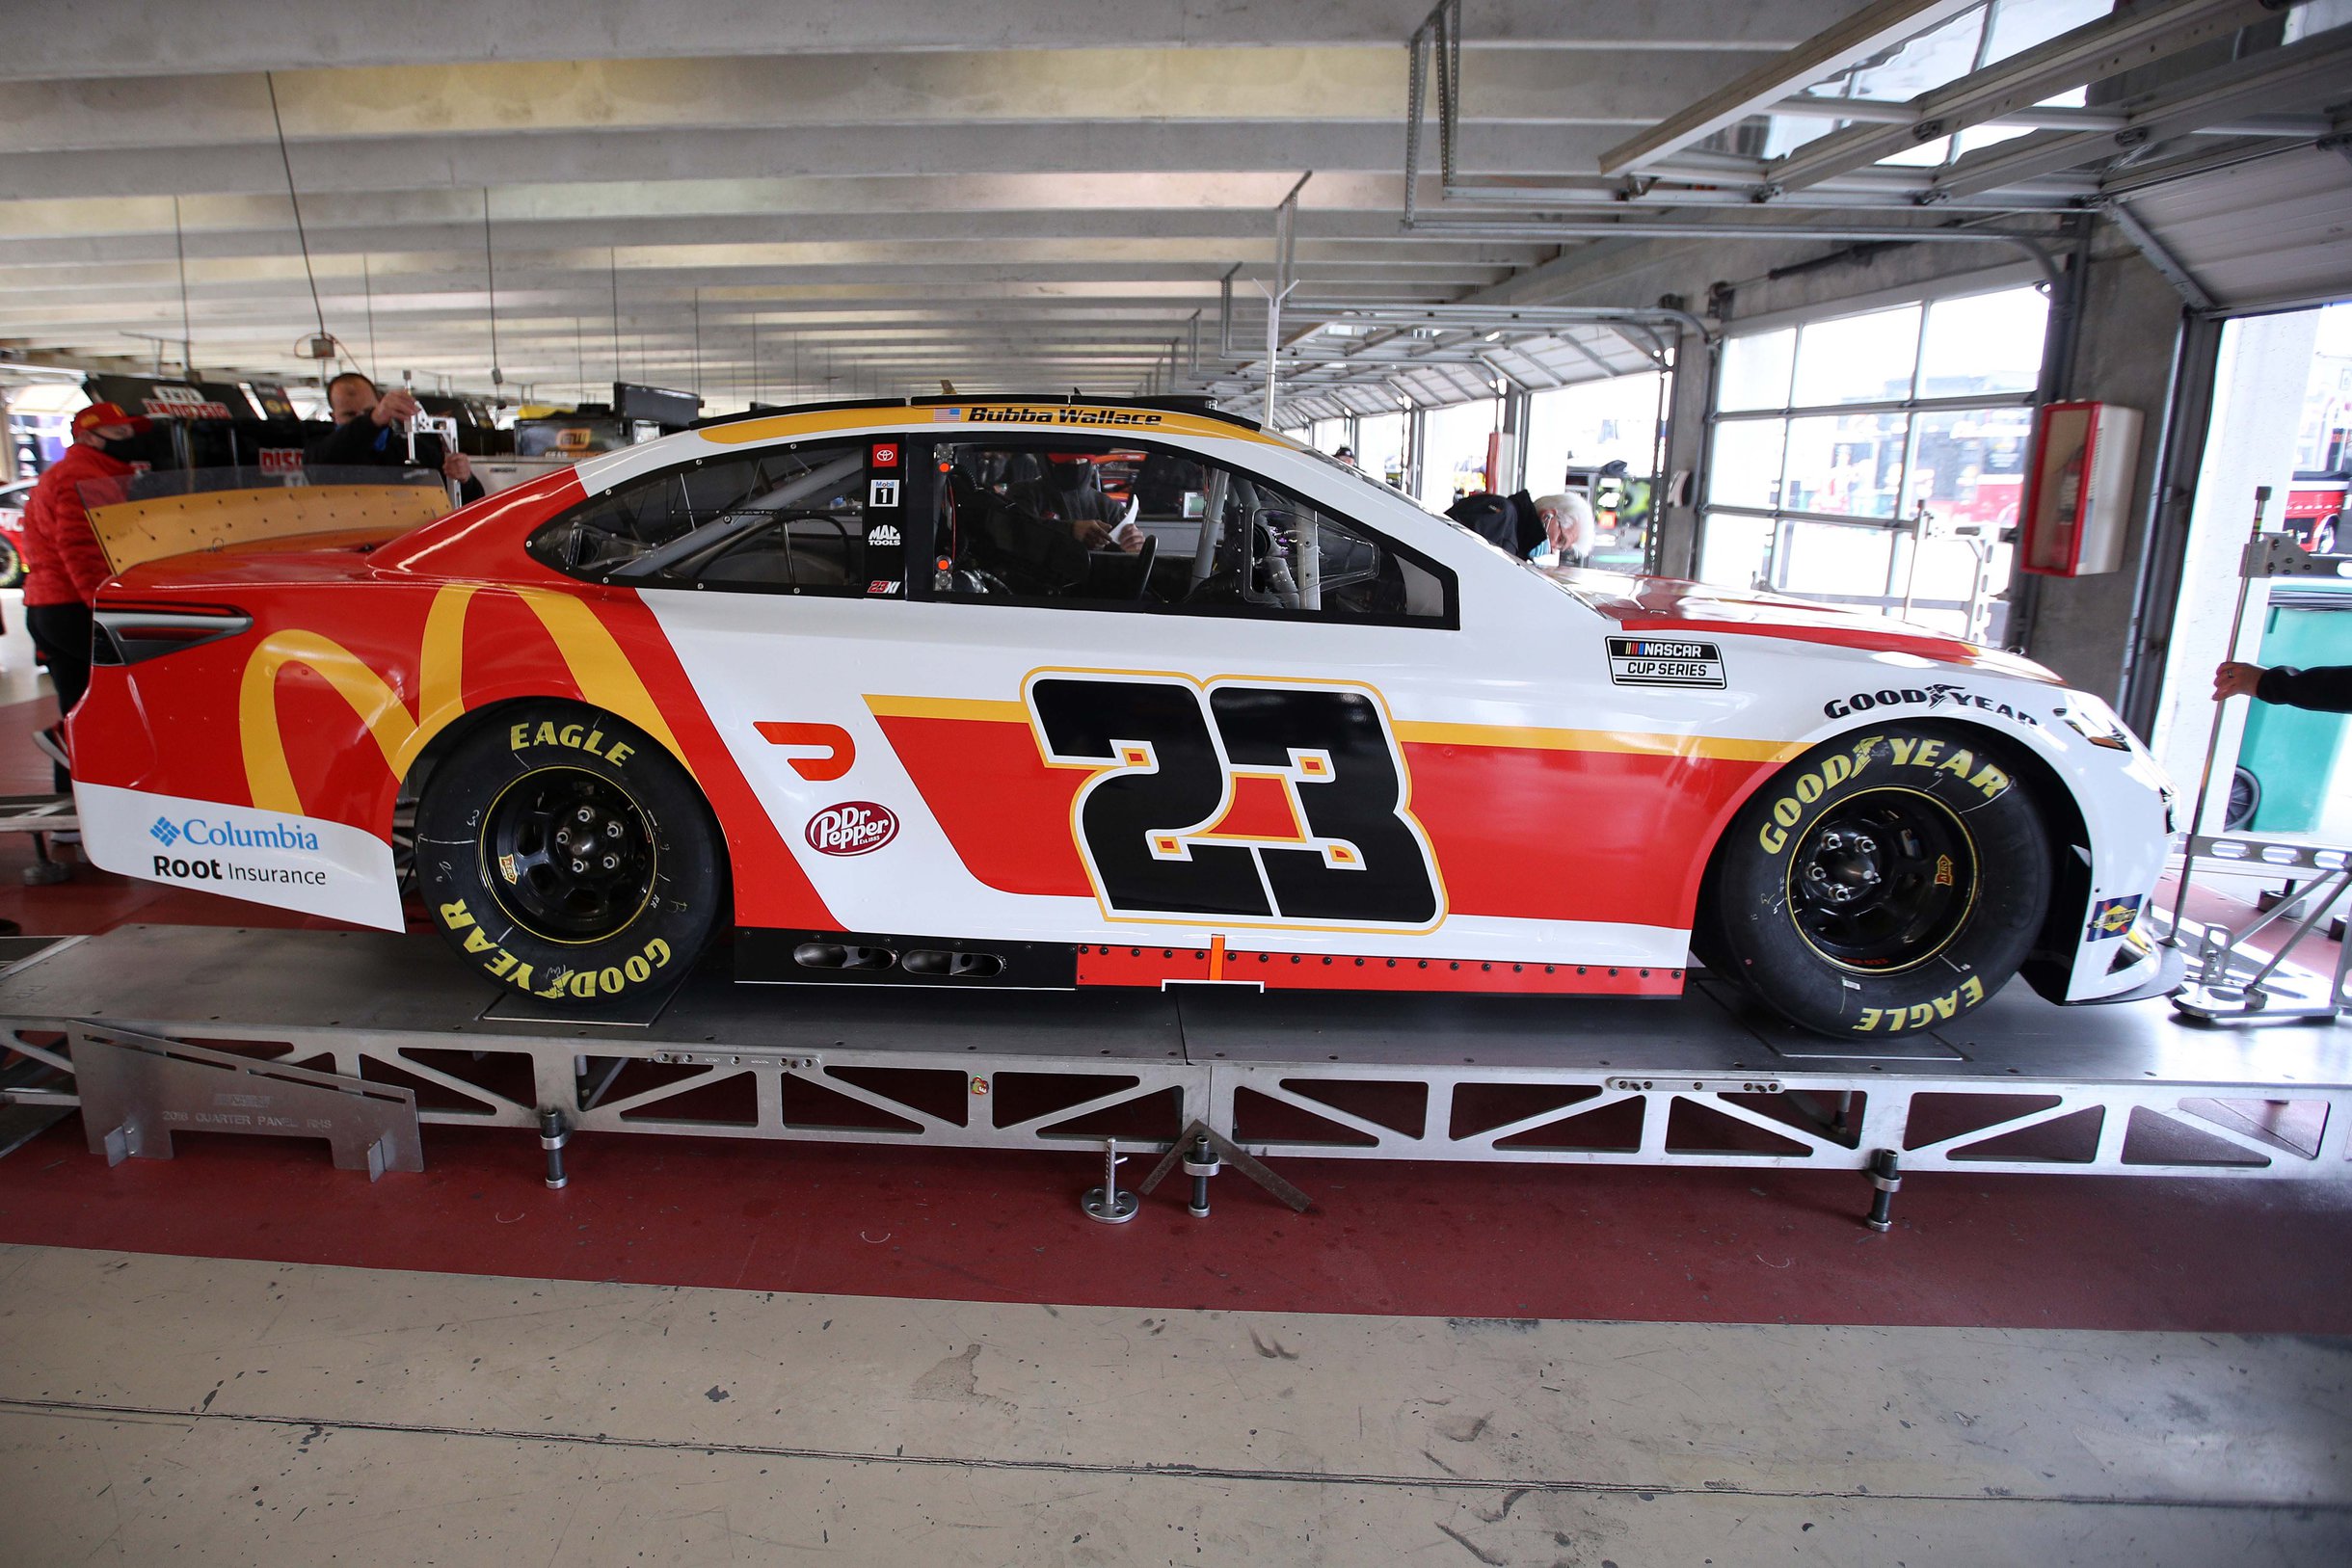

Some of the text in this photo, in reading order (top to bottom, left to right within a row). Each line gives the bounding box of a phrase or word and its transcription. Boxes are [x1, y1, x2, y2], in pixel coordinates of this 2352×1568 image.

[968, 408, 1163, 426] Bubba Wallace
[881, 488, 888, 504] 1
[869, 524, 901, 540] MAC
[868, 580, 901, 594] 23XI
[1644, 643, 1702, 657] NASCAR
[1627, 662, 1707, 677] CUP SERIES
[510, 721, 636, 767] EAGLE
[1028, 673, 1442, 928] 23
[842, 807, 871, 830] Dr
[182, 819, 320, 851] Columbia
[818, 811, 889, 850] Pepper
[152, 855, 327, 885] Root Insurance
[1852, 975, 1984, 1031] EAGLE
[195, 1111, 252, 1126] QUARTER
[257, 1115, 299, 1128] PANEL
